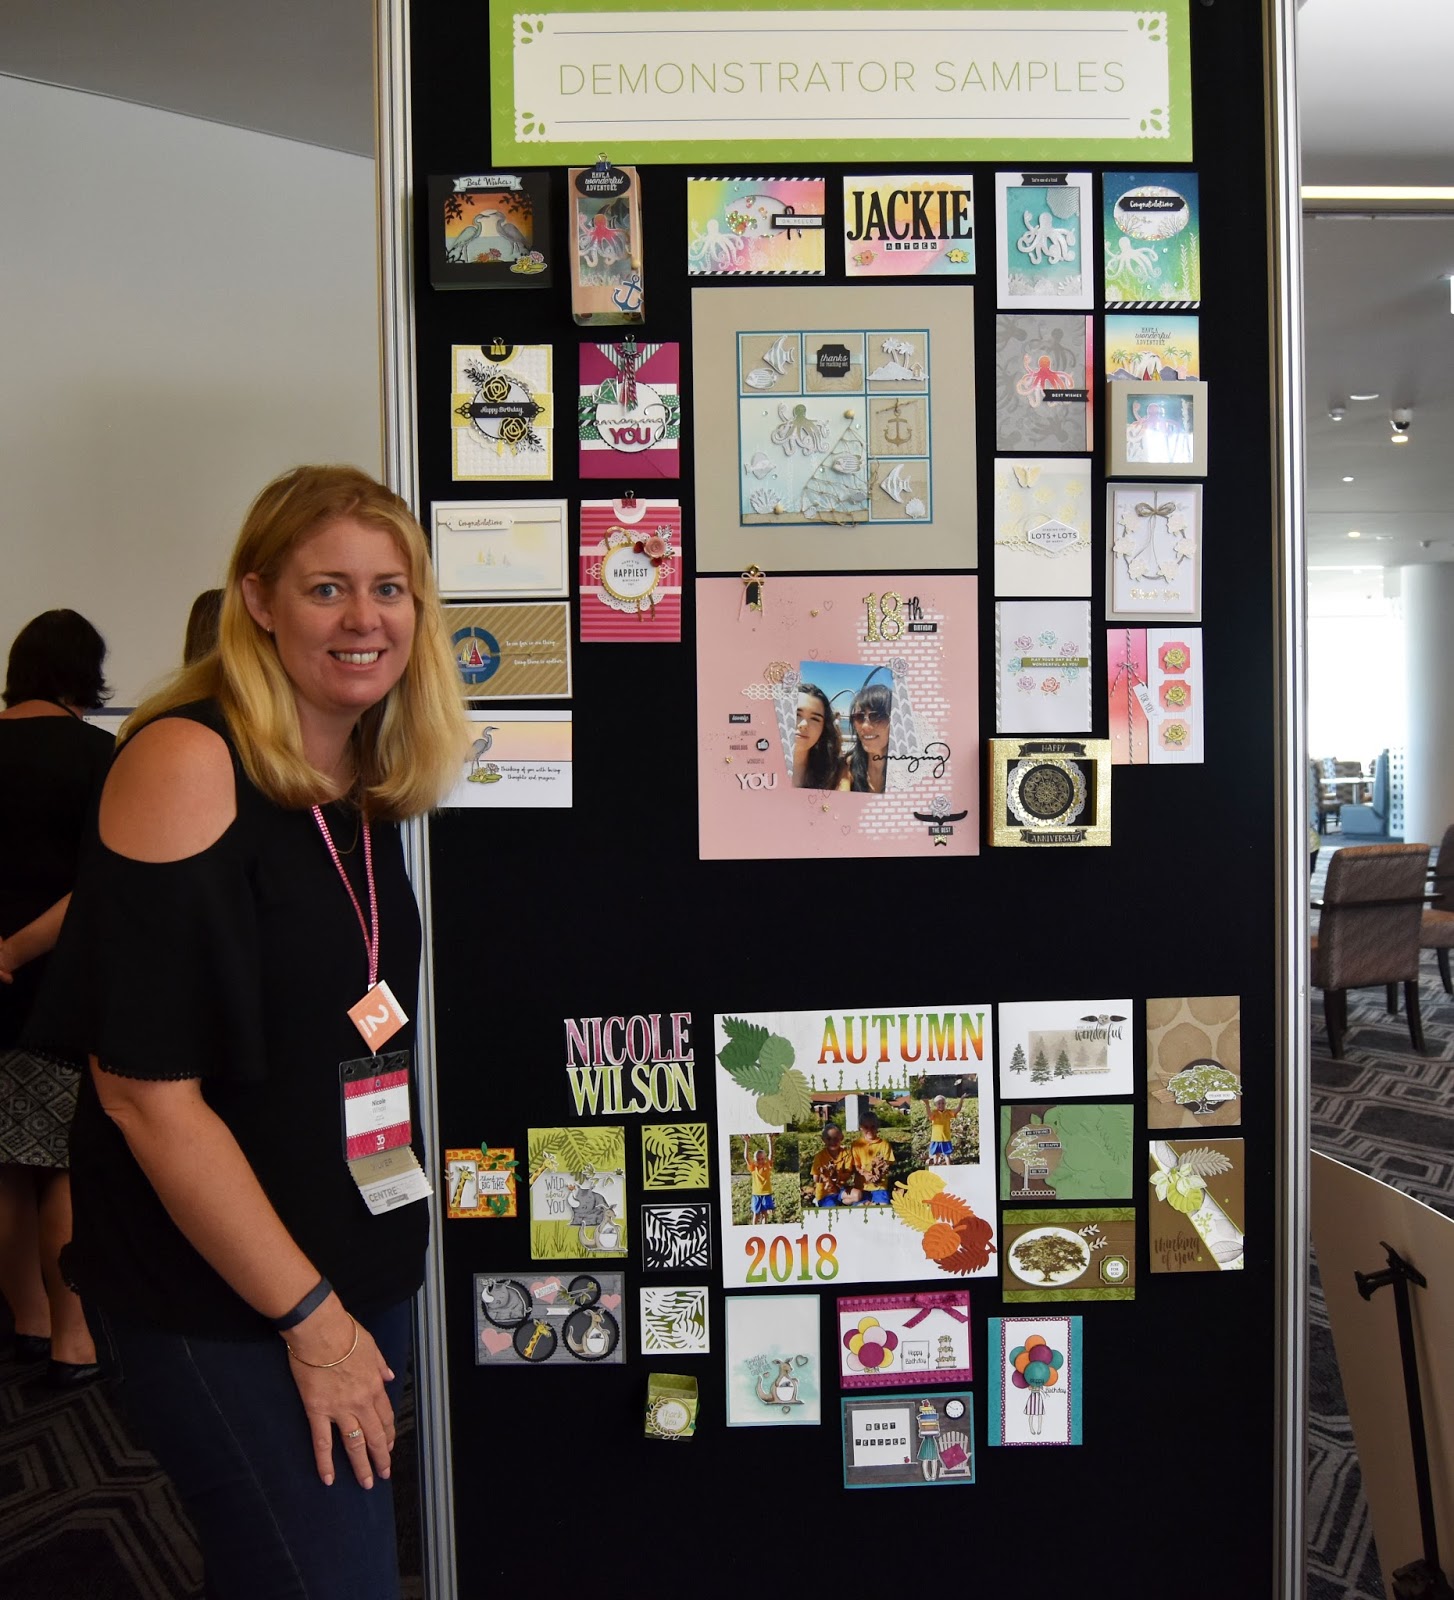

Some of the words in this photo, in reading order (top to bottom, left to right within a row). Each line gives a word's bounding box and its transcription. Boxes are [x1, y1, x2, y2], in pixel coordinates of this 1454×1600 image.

[559, 60, 916, 96] DEMONSTRATOR
[934, 60, 1126, 94] SAMPLES
[463, 177, 482, 187] Best
[483, 176, 512, 187] Wishes
[585, 176, 624, 185] wonderful
[1130, 199, 1174, 210] Congratulations
[846, 189, 973, 241] JACKIE
[886, 241, 938, 251] AITKEN
[820, 353, 848, 362] thanks
[480, 405, 499, 415] Happy
[499, 406, 524, 417] Birthday
[609, 427, 651, 445] YOU
[458, 518, 502, 528] Congratulations
[1031, 532, 1051, 540] LOTS
[613, 568, 648, 578] HAPPIEST
[1041, 744, 1067, 752] HAPPY
[872, 742, 951, 779] amazing
[735, 772, 778, 790] YOU
[1031, 834, 1080, 843] ANNIVERSARY
[563, 1011, 695, 1067] NICOLE
[817, 1012, 986, 1065] AUTUMN
[1075, 1022, 1123, 1046] wonderful
[565, 1061, 697, 1117] WILSON
[372, 1098, 386, 1106] Nicole
[481, 1181, 490, 1190] BIG
[492, 1180, 505, 1190] TIME
[545, 1175, 565, 1191] WILD
[368, 1187, 398, 1203] CENTRE
[546, 1199, 566, 1215] YOU
[744, 1233, 840, 1284] 2018
[865, 1422, 896, 1431] BEST
[855, 1438, 907, 1446] TEACHER
